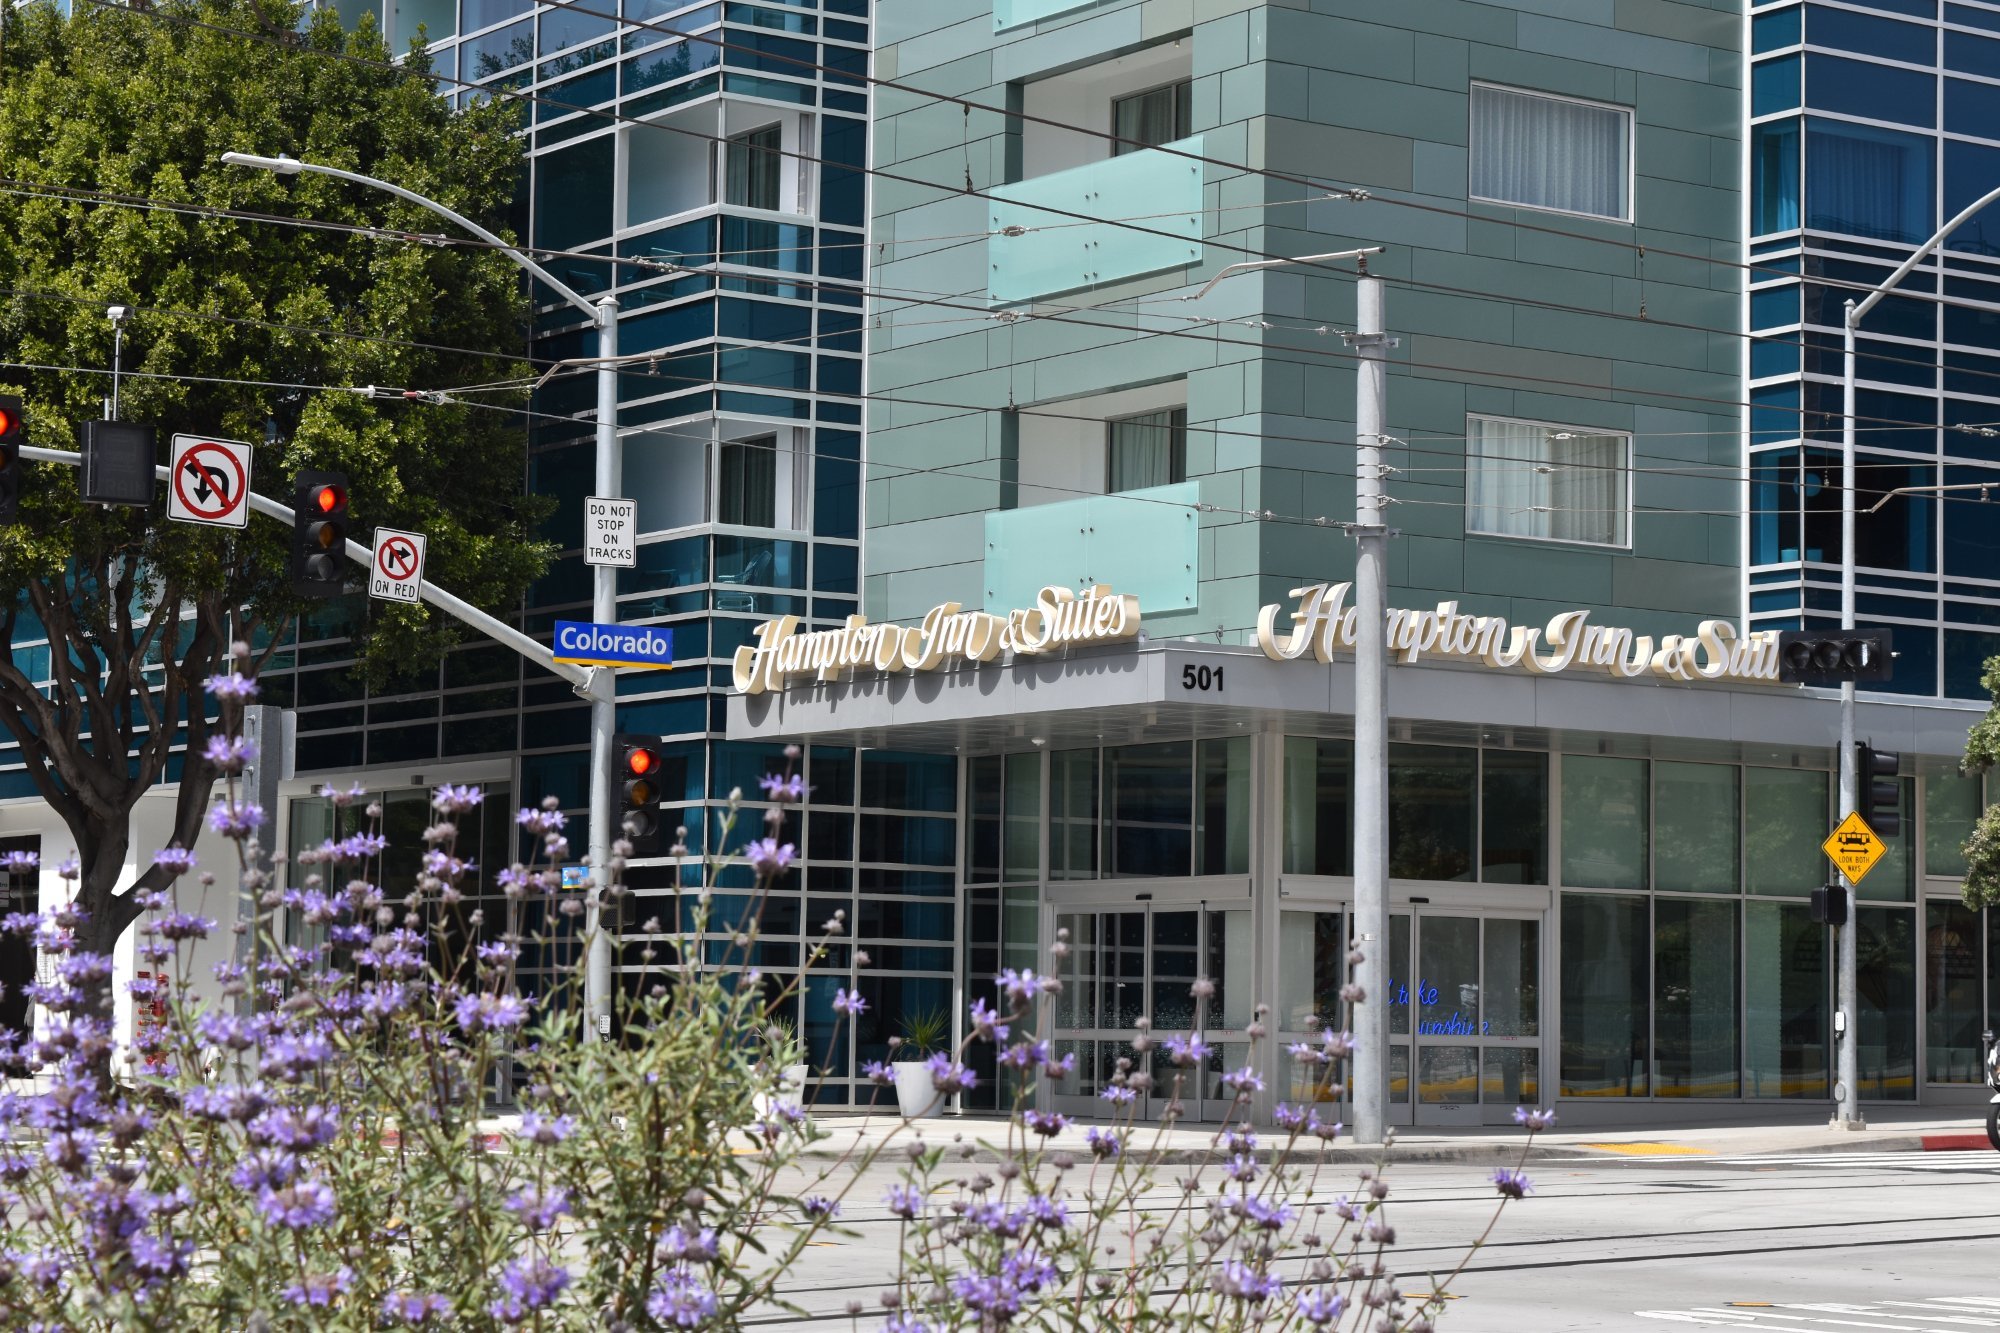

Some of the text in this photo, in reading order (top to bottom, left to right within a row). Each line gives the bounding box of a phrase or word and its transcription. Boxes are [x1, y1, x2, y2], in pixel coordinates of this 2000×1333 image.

[590, 504, 632, 517] DO NOT
[597, 519, 624, 531] STOP
[603, 533, 618, 544] ON
[589, 547, 632, 559] TRACKS
[375, 579, 416, 598] ON RED
[560, 626, 667, 656] Colorado
[732, 583, 1140, 695] Hampton Inn & Suites
[1521, 609, 1654, 678] Inn
[1651, 634, 1695, 681] &
[1684, 620, 1782, 680] Suit
[1182, 663, 1224, 692] 501
